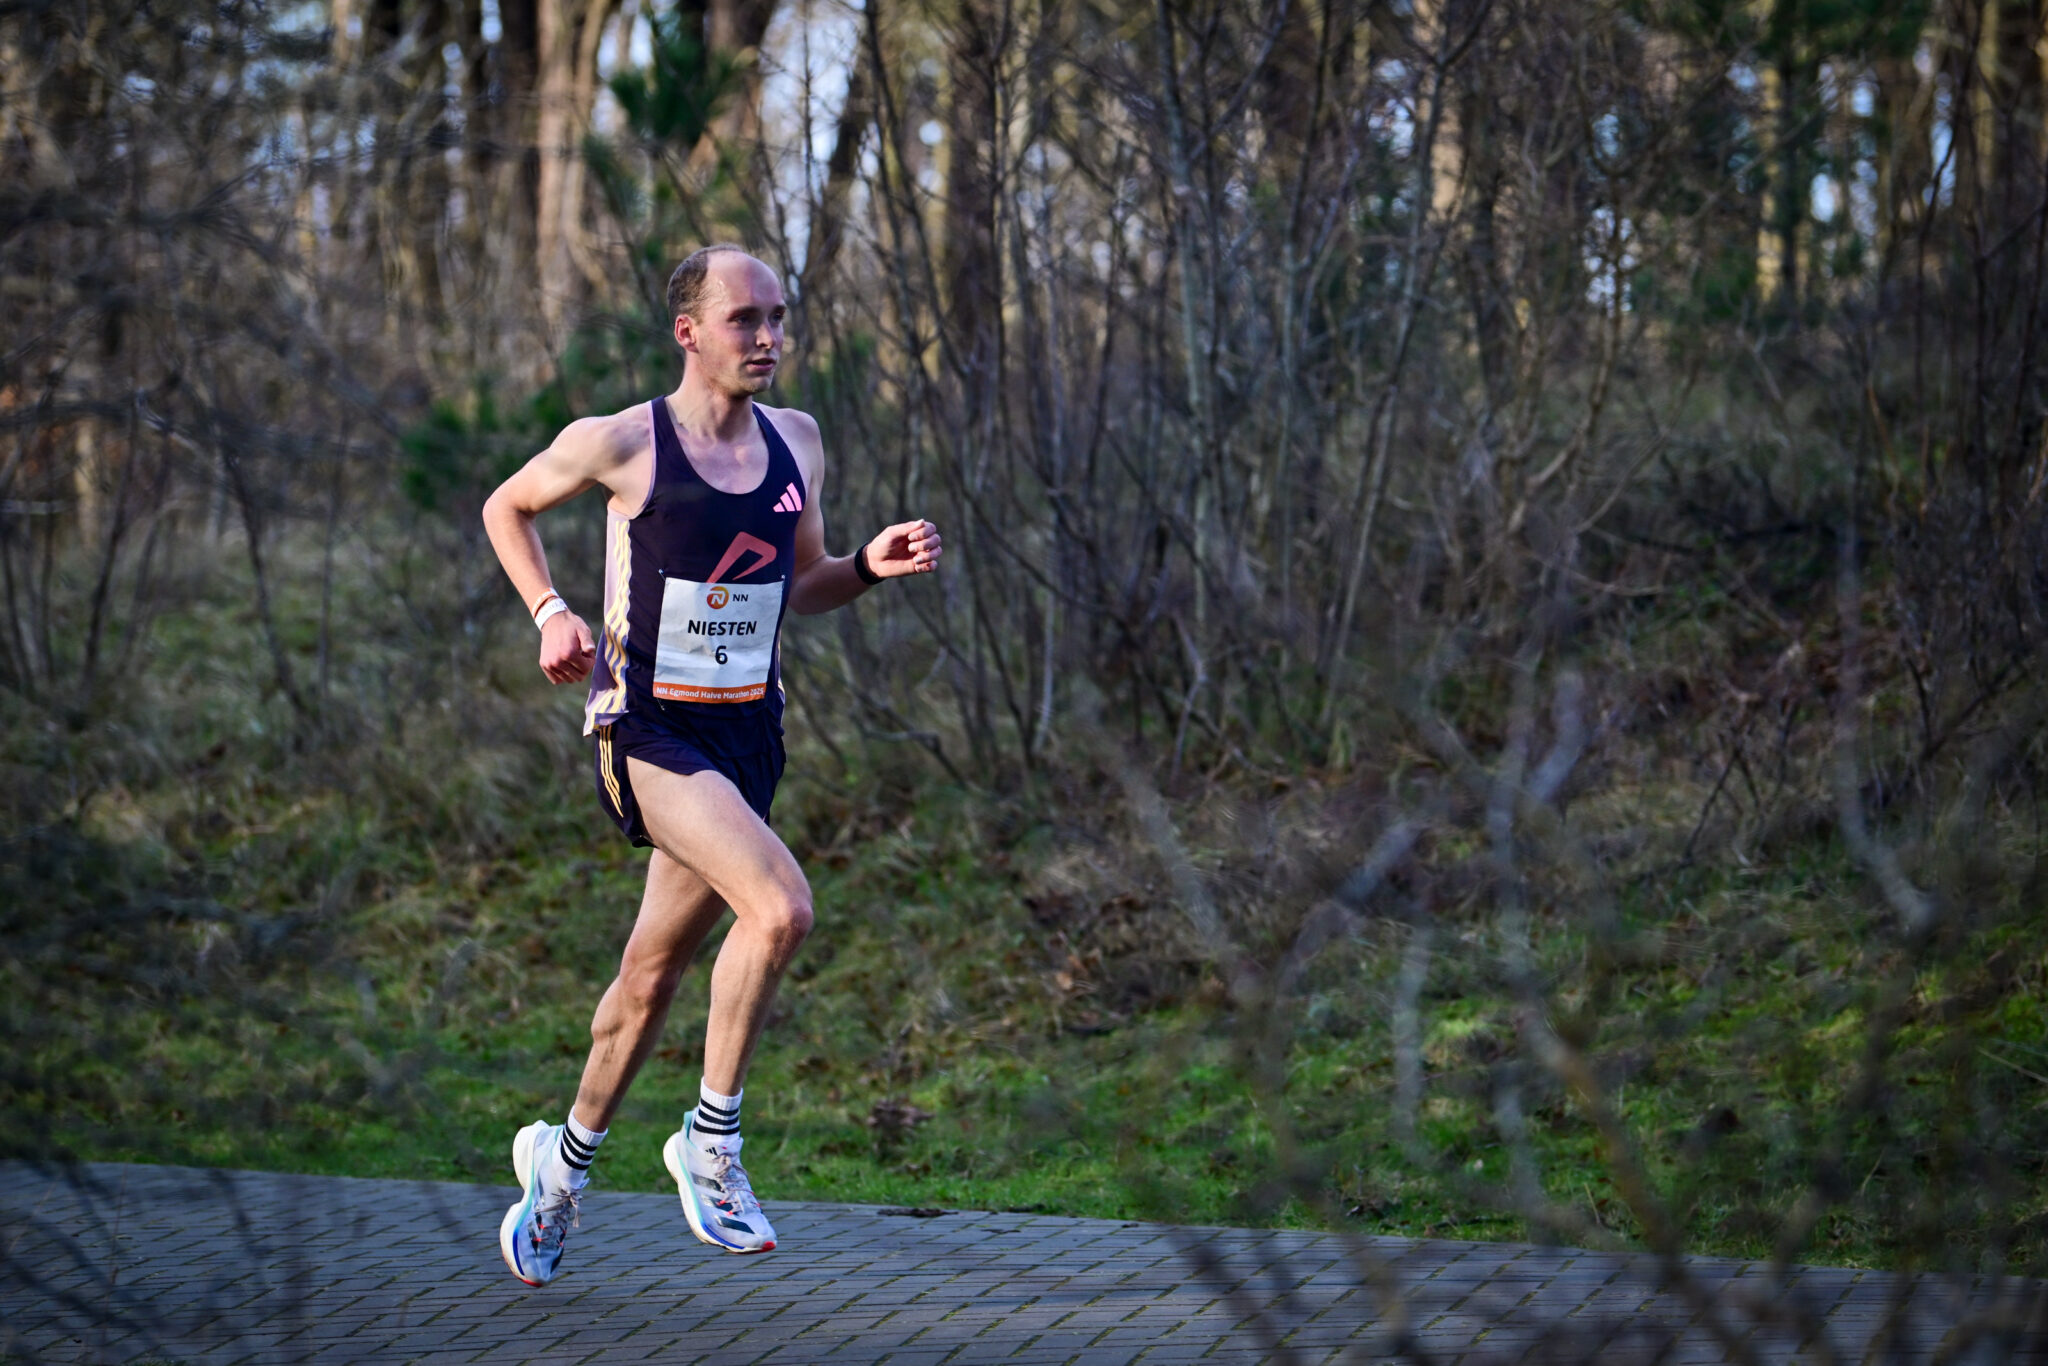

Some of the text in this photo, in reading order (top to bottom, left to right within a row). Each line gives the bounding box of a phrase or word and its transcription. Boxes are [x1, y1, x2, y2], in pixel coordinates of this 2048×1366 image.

[687, 619, 757, 636] NIESTEN
[715, 645, 728, 664] 6
[656, 686, 668, 695] NN
[669, 688, 700, 698] Egmond
[700, 691, 722, 699] Halve
[722, 690, 750, 699] Marathon
